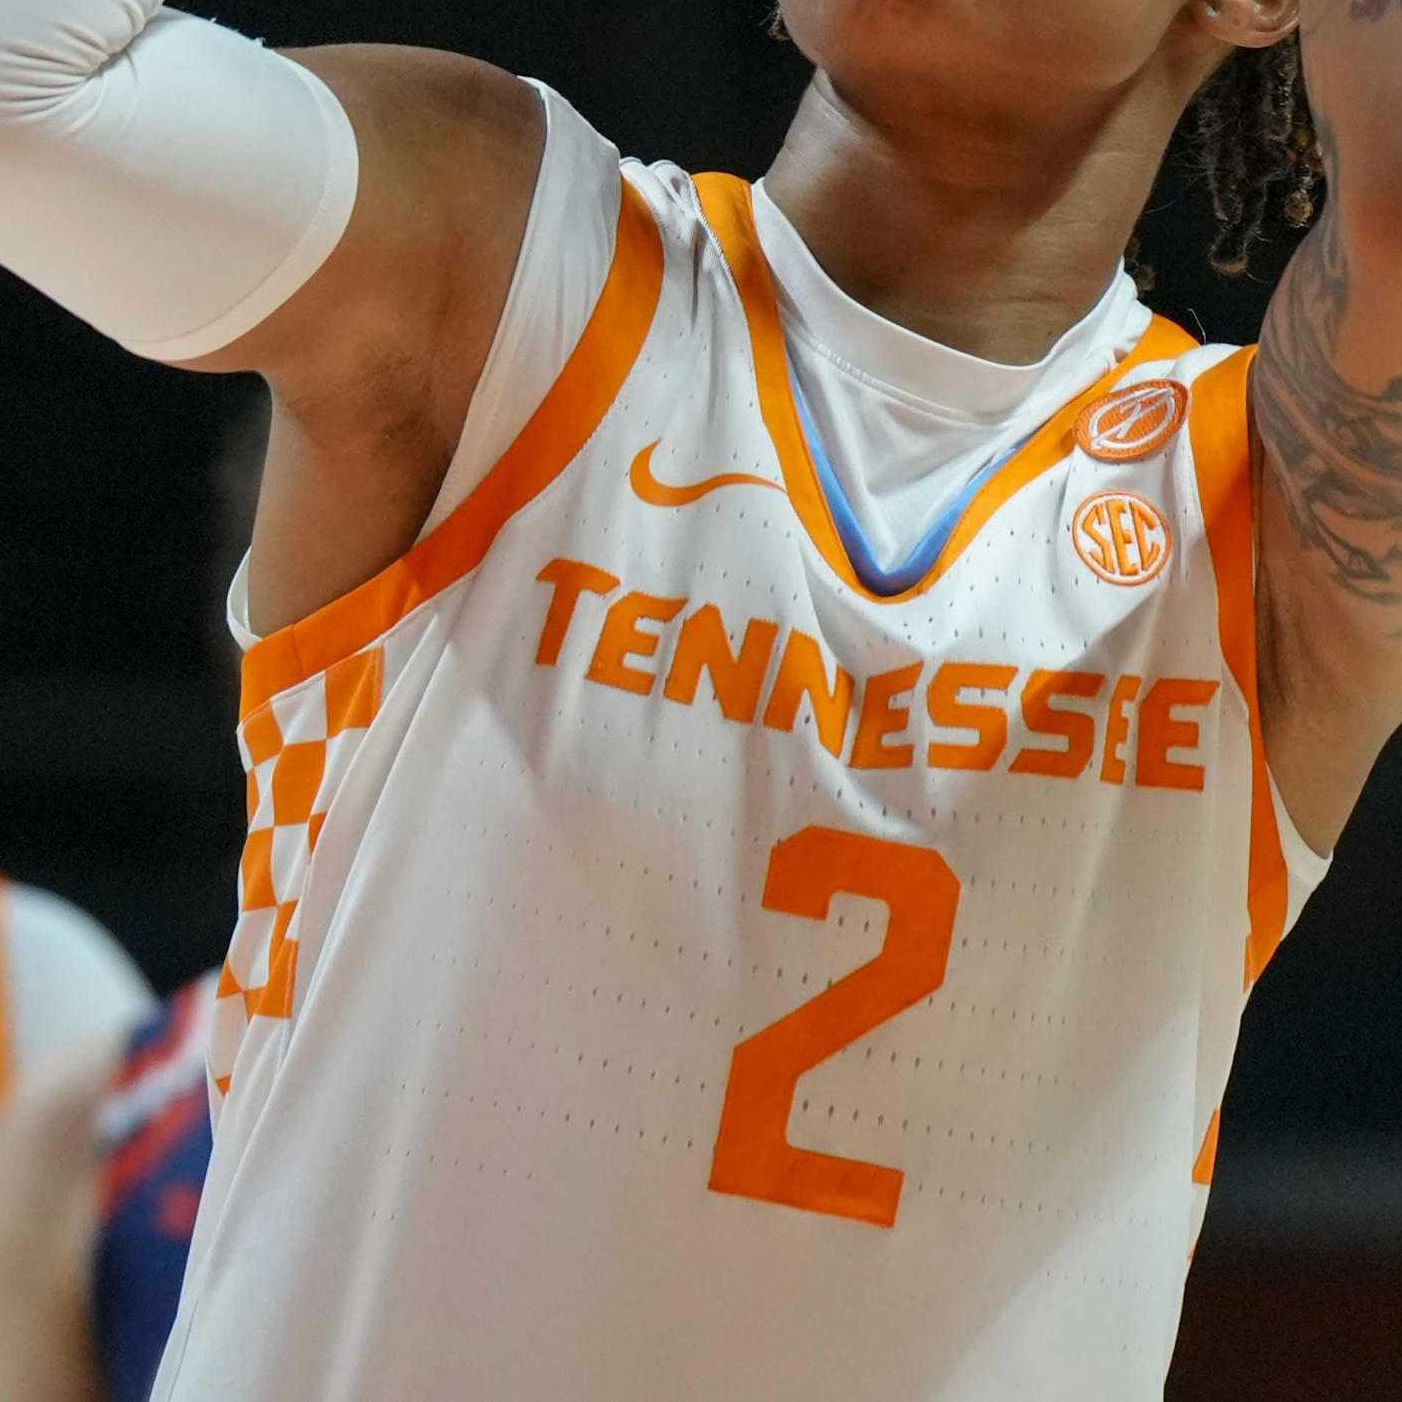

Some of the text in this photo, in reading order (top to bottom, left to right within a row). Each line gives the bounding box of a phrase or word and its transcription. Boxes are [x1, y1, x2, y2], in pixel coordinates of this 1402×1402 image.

[1082, 498, 1161, 577] SEC
[534, 558, 1221, 793] TENNESSEE
[708, 824, 961, 1229] 2
